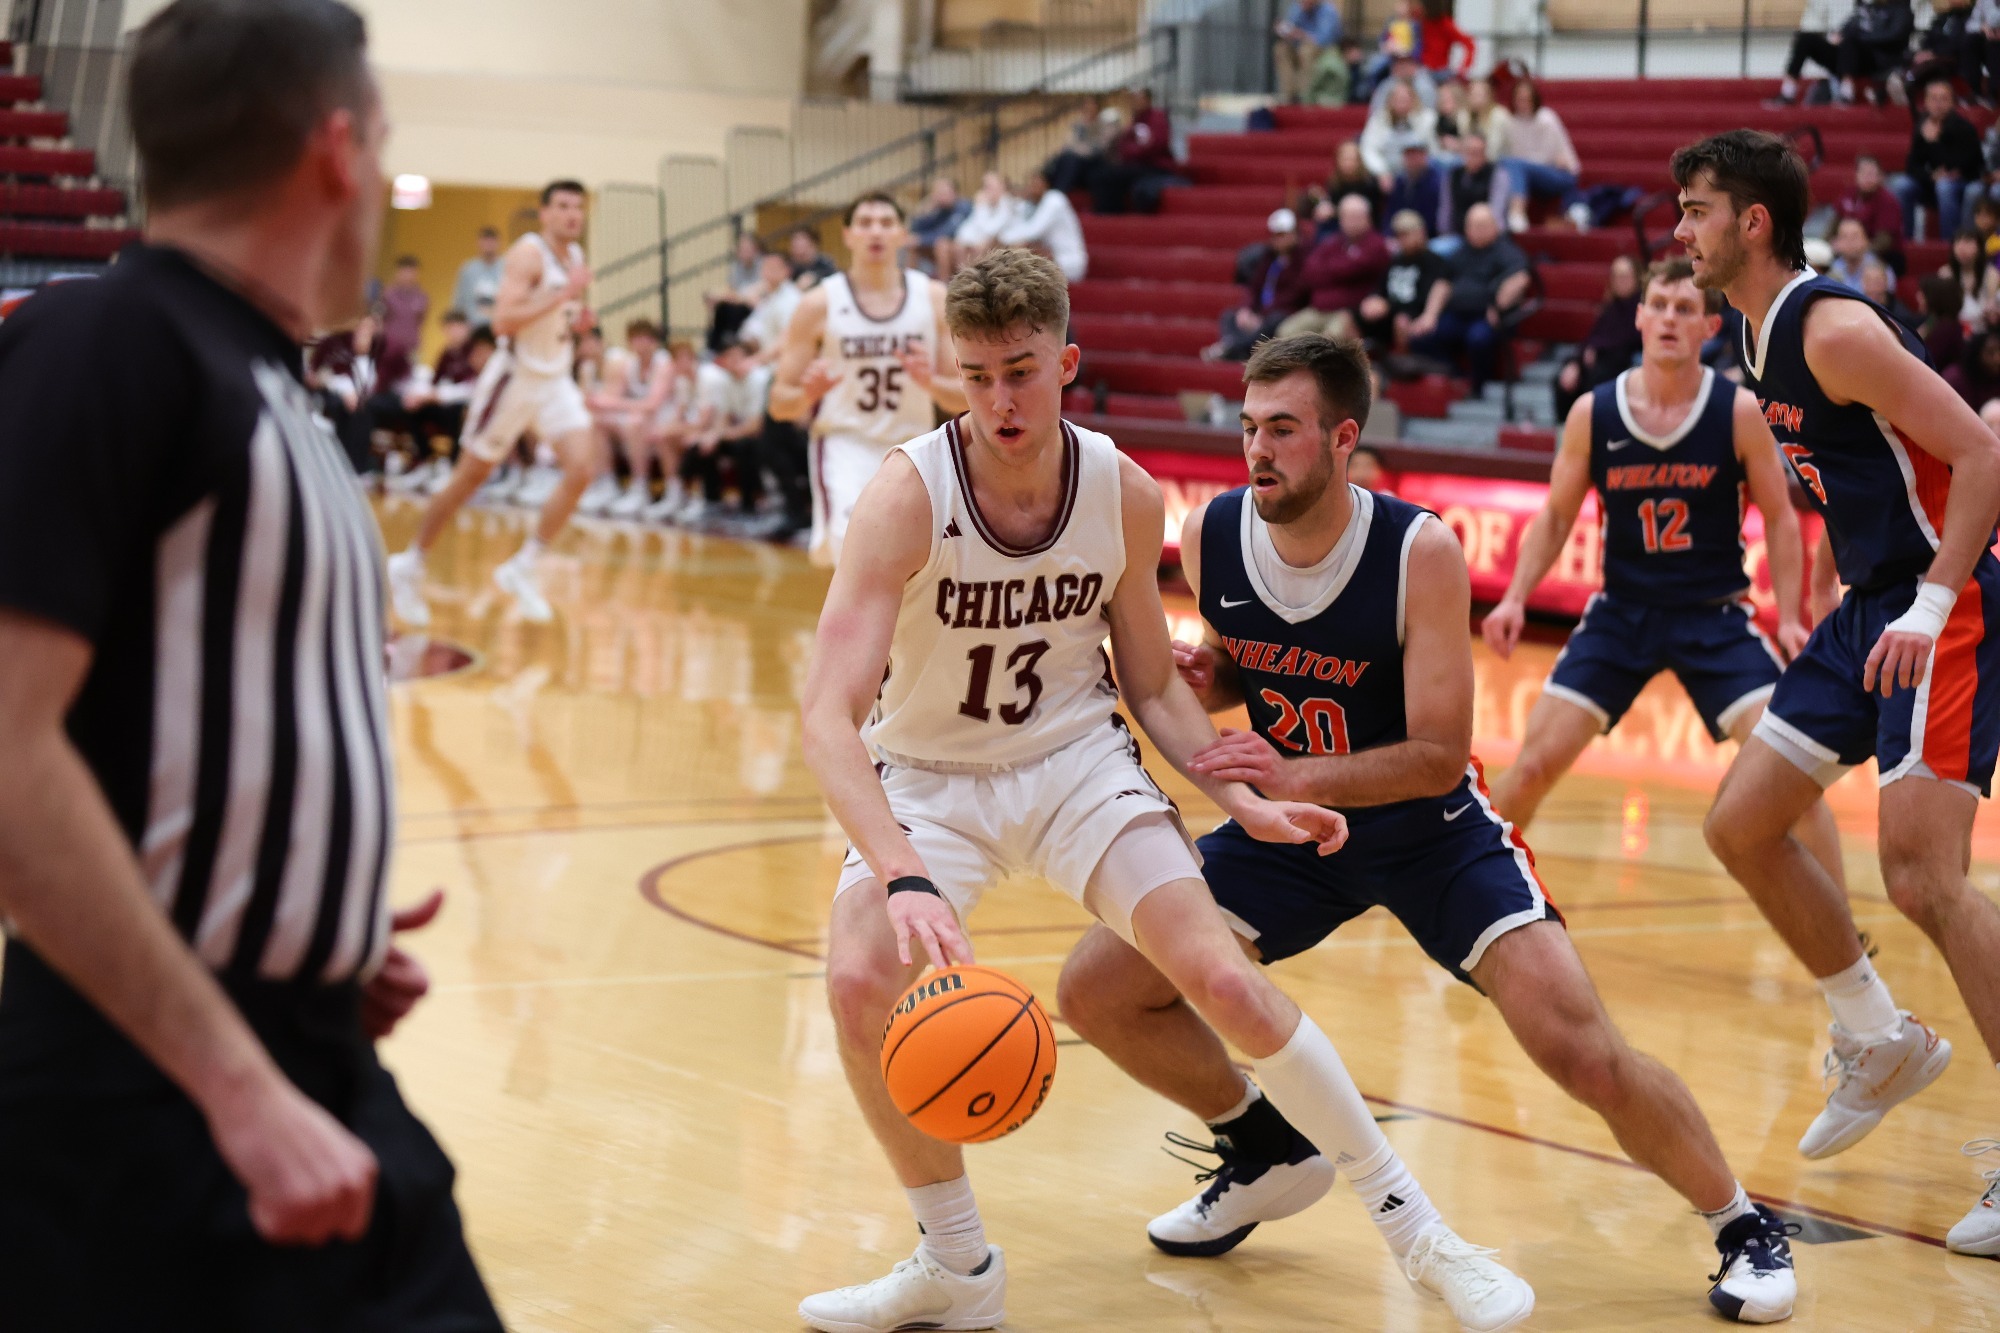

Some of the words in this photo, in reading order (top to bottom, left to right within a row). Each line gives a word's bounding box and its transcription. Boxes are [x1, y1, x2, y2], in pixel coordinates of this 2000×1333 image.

[857, 366, 903, 412] 35
[1606, 463, 1717, 491] WHEATON
[1638, 498, 1693, 554] 12
[935, 572, 1104, 630] CHICAGO
[957, 638, 1052, 726] 13
[1222, 635, 1371, 688] WHEATON
[1260, 687, 1351, 756] 20
